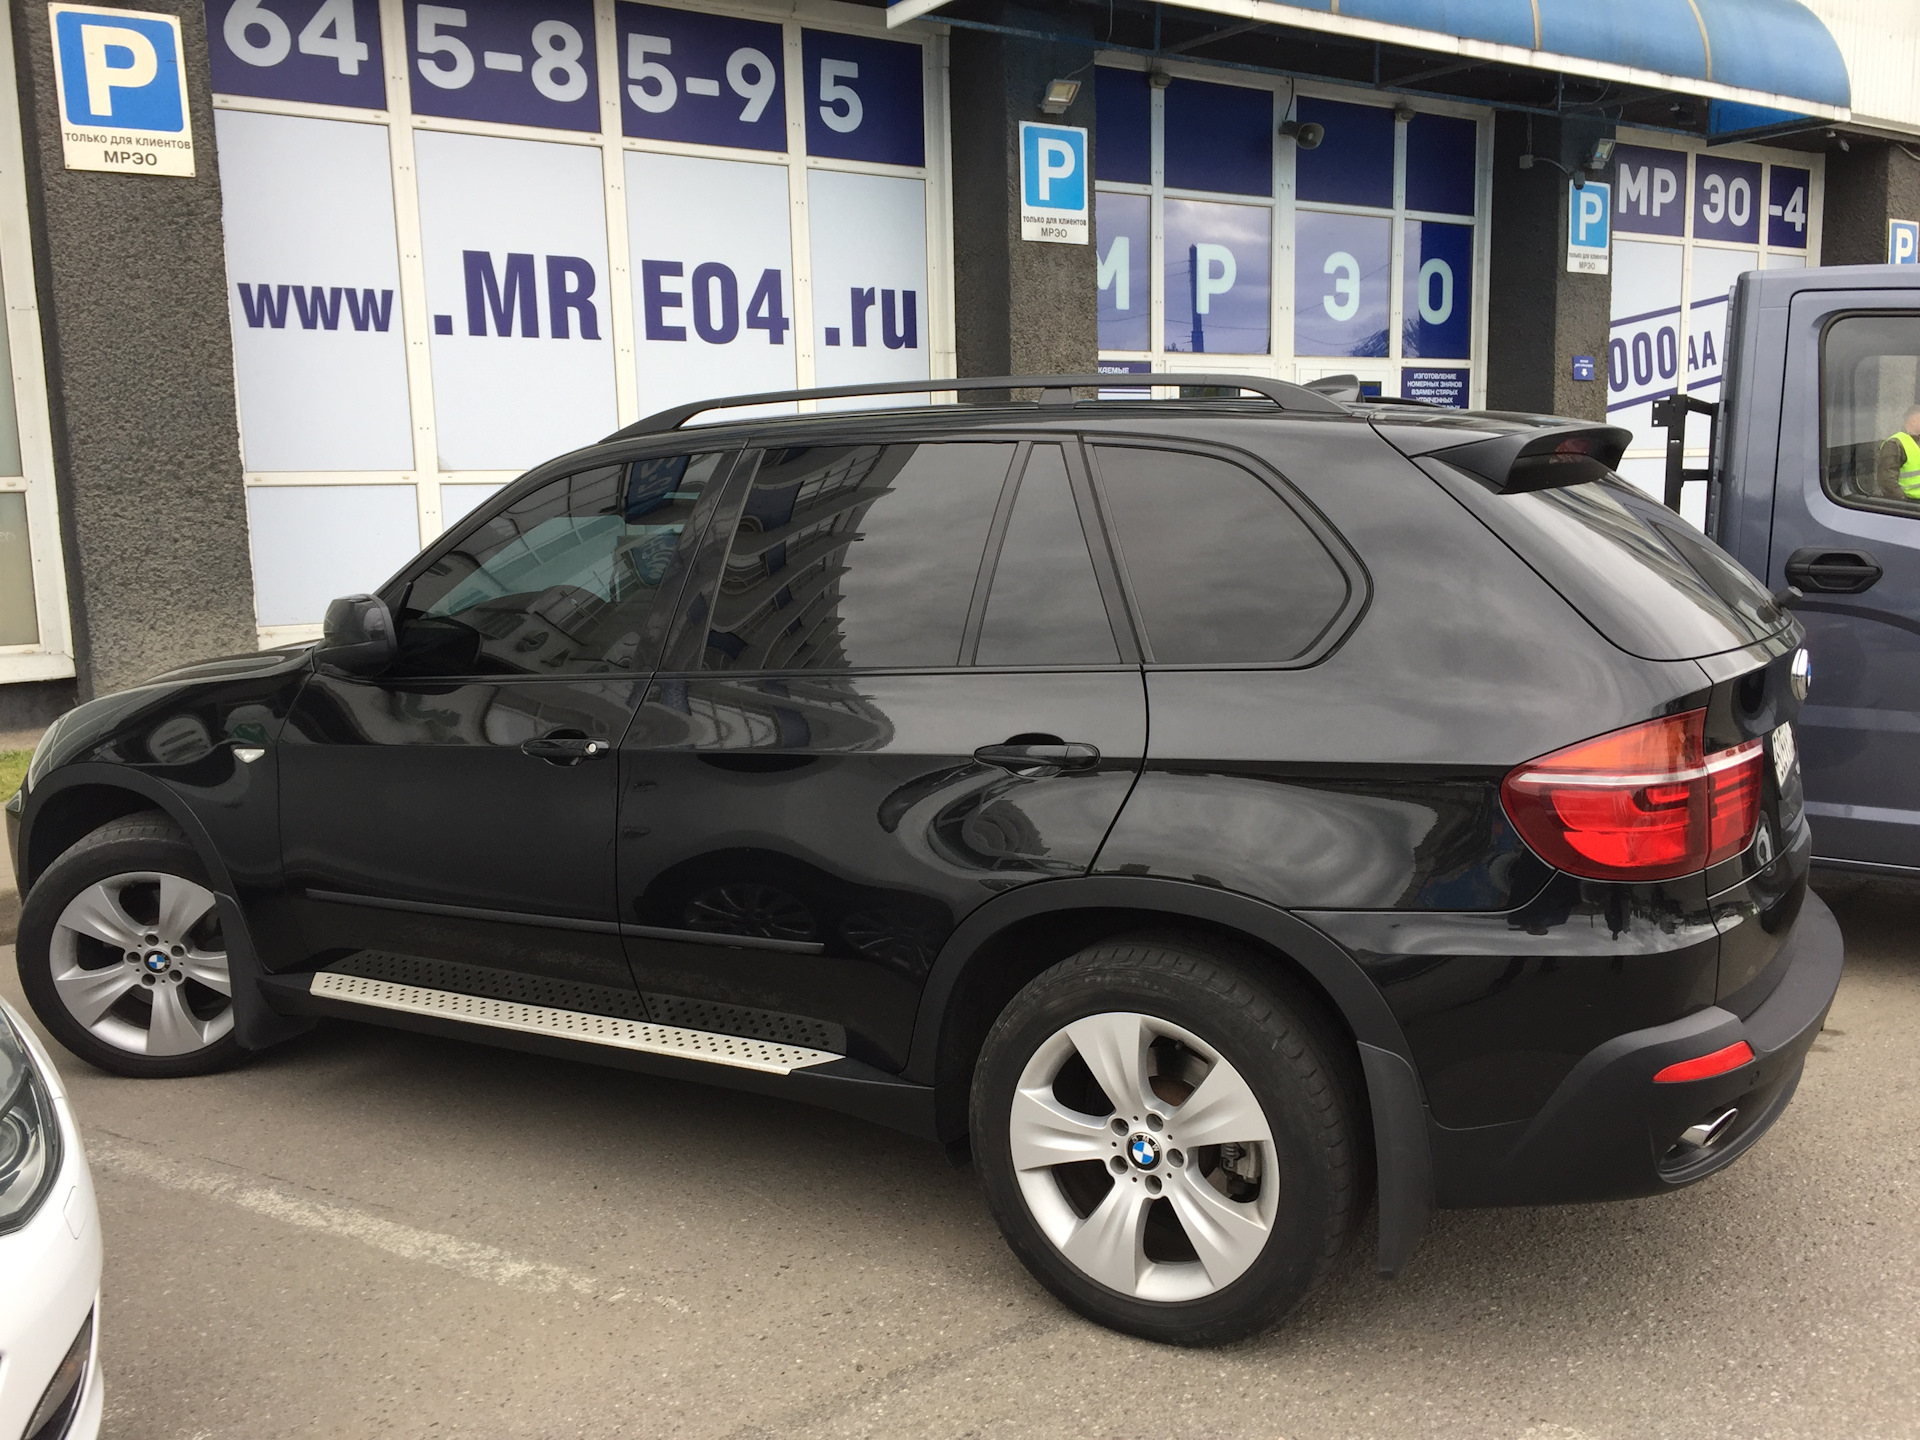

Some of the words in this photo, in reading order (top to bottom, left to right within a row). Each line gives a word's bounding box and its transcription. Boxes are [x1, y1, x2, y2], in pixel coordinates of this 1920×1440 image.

[81, 24, 158, 117] P
[64, 132, 108, 145] только
[110, 135, 133, 147] для
[135, 137, 191, 150] клиентов
[104, 151, 158, 166] МРЭО
[1038, 137, 1076, 201] P
[1023, 216, 1044, 224] только
[1046, 217, 1057, 225] для
[1058, 218, 1086, 226] клиентов
[1579, 192, 1603, 241] P
[1041, 227, 1067, 238] МРЭО
[1895, 227, 1913, 265] P
[1579, 261, 1595, 269] МРЭО
